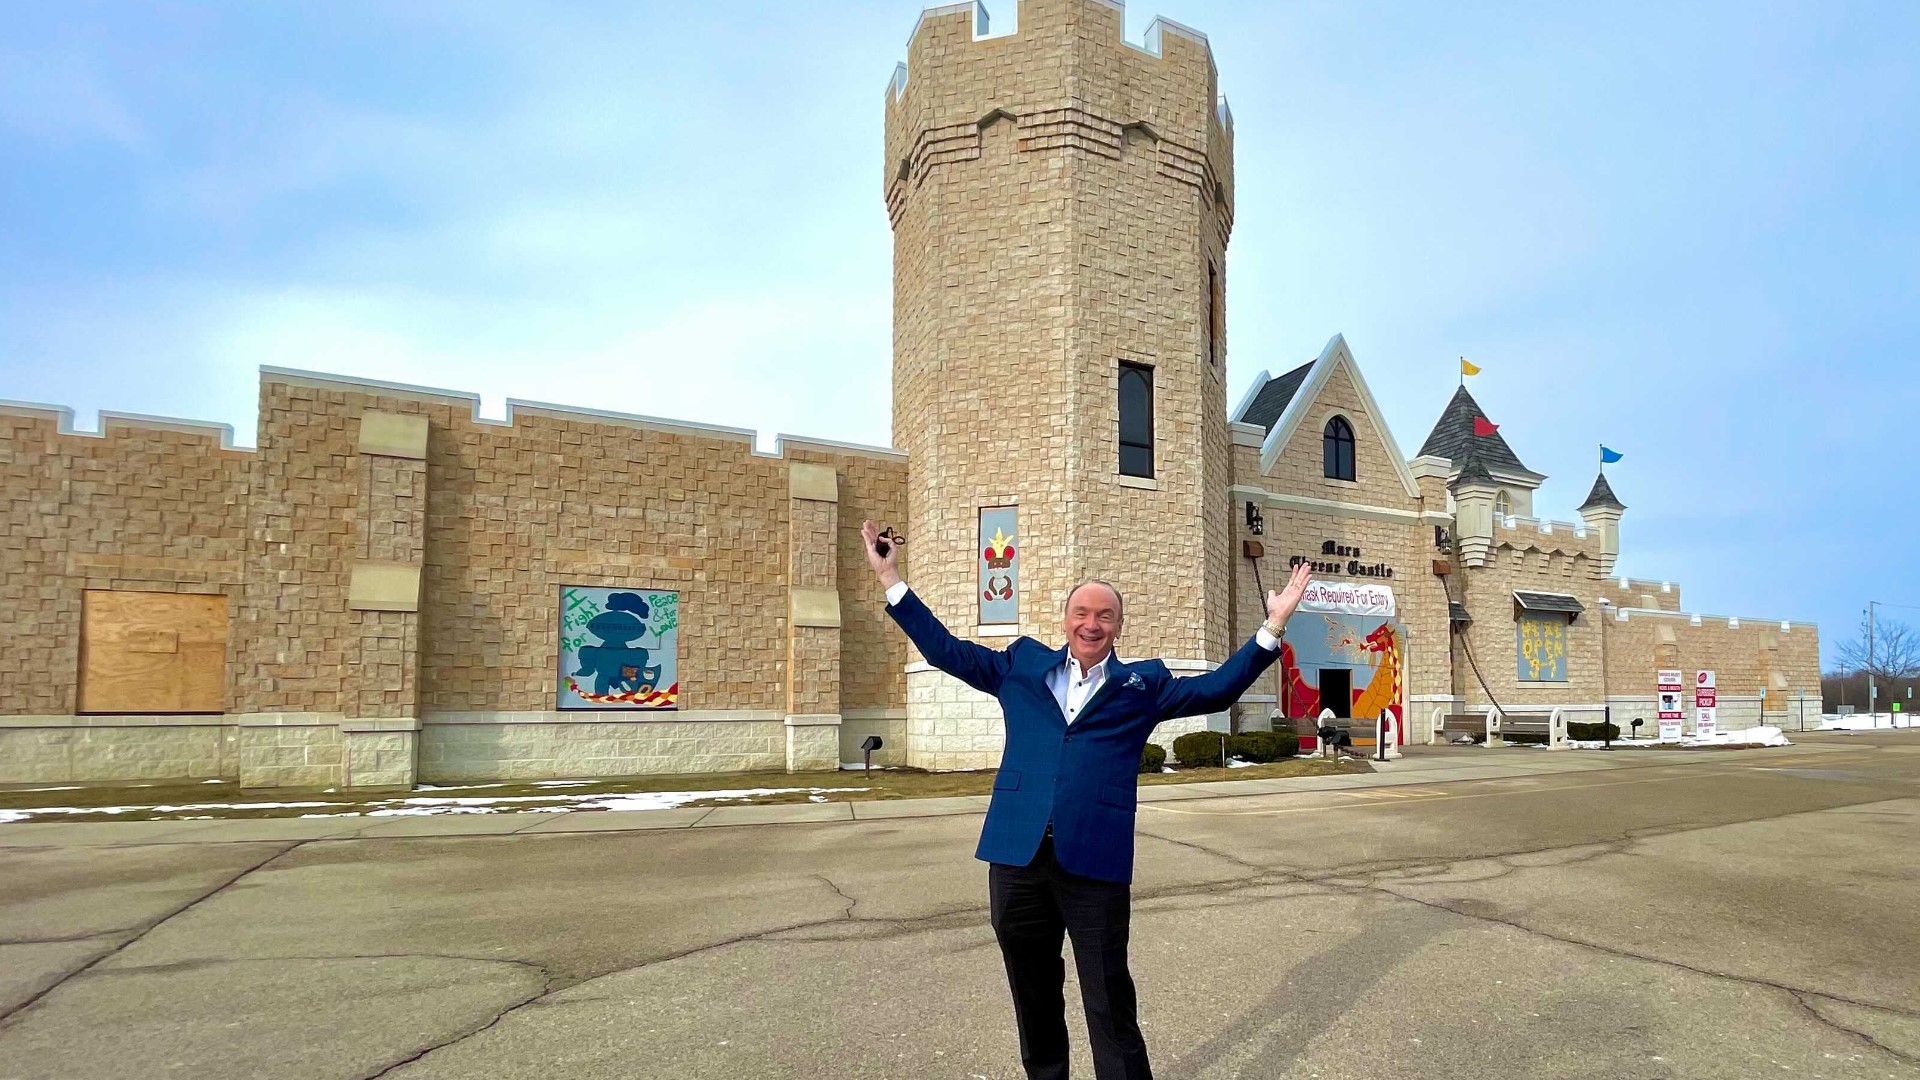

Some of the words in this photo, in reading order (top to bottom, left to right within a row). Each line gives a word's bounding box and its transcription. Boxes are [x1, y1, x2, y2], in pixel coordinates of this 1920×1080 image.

[1321, 540, 1360, 557] Mars
[1347, 560, 1393, 577] Castle
[562, 589, 588, 611] I
[1319, 586, 1355, 608] Required
[1354, 590, 1369, 605] For
[1368, 590, 1389, 610] Entry
[564, 600, 600, 631] fight
[561, 633, 586, 652] for
